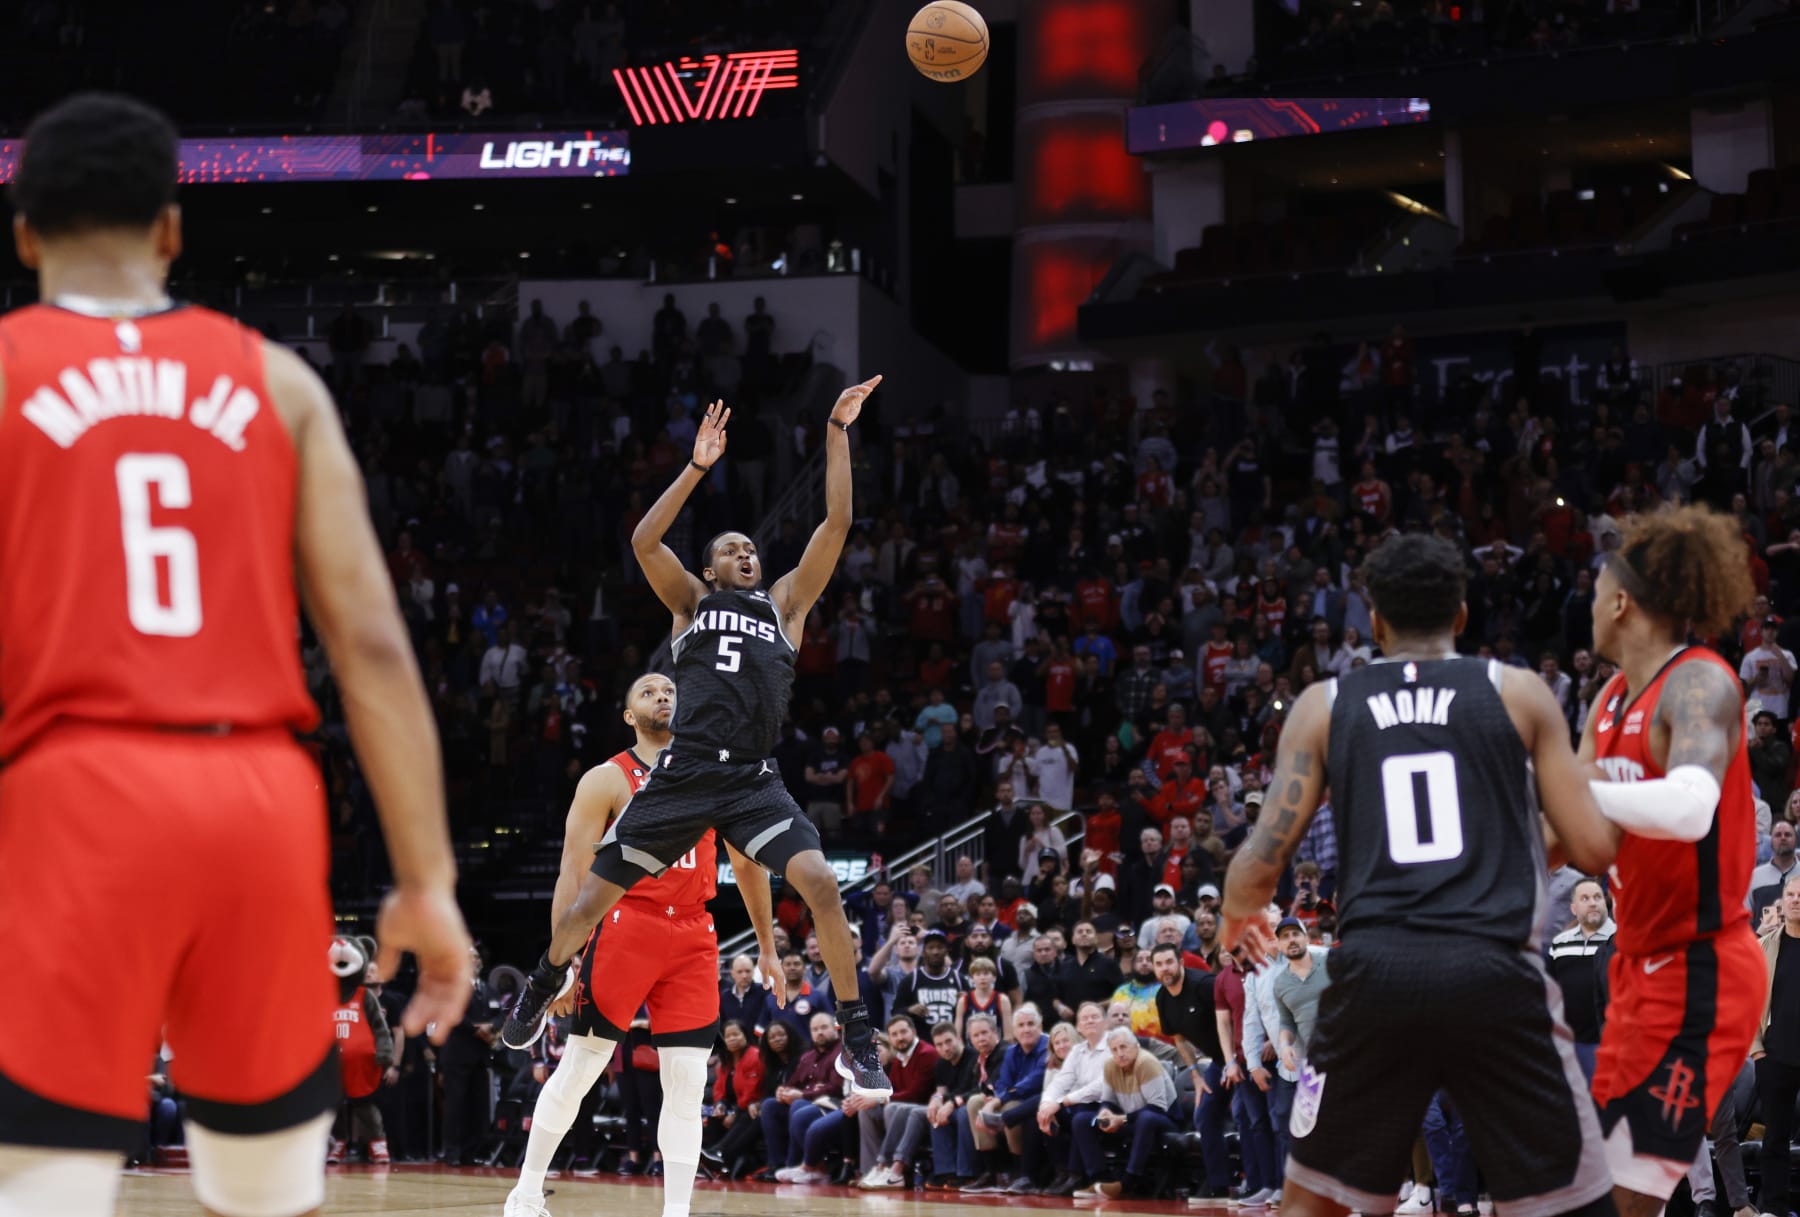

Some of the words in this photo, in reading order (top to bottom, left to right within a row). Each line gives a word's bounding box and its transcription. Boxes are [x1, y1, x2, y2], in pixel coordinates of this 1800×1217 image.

[479, 140, 602, 169] LIGHT
[20, 355, 188, 450] MARTIN
[115, 451, 204, 638] 6
[693, 609, 777, 644] KINGS
[715, 634, 744, 673] 5
[1366, 686, 1457, 731] MONK
[1380, 750, 1464, 865] 0
[917, 988, 957, 1004] KINGS
[925, 1004, 953, 1025] 55
